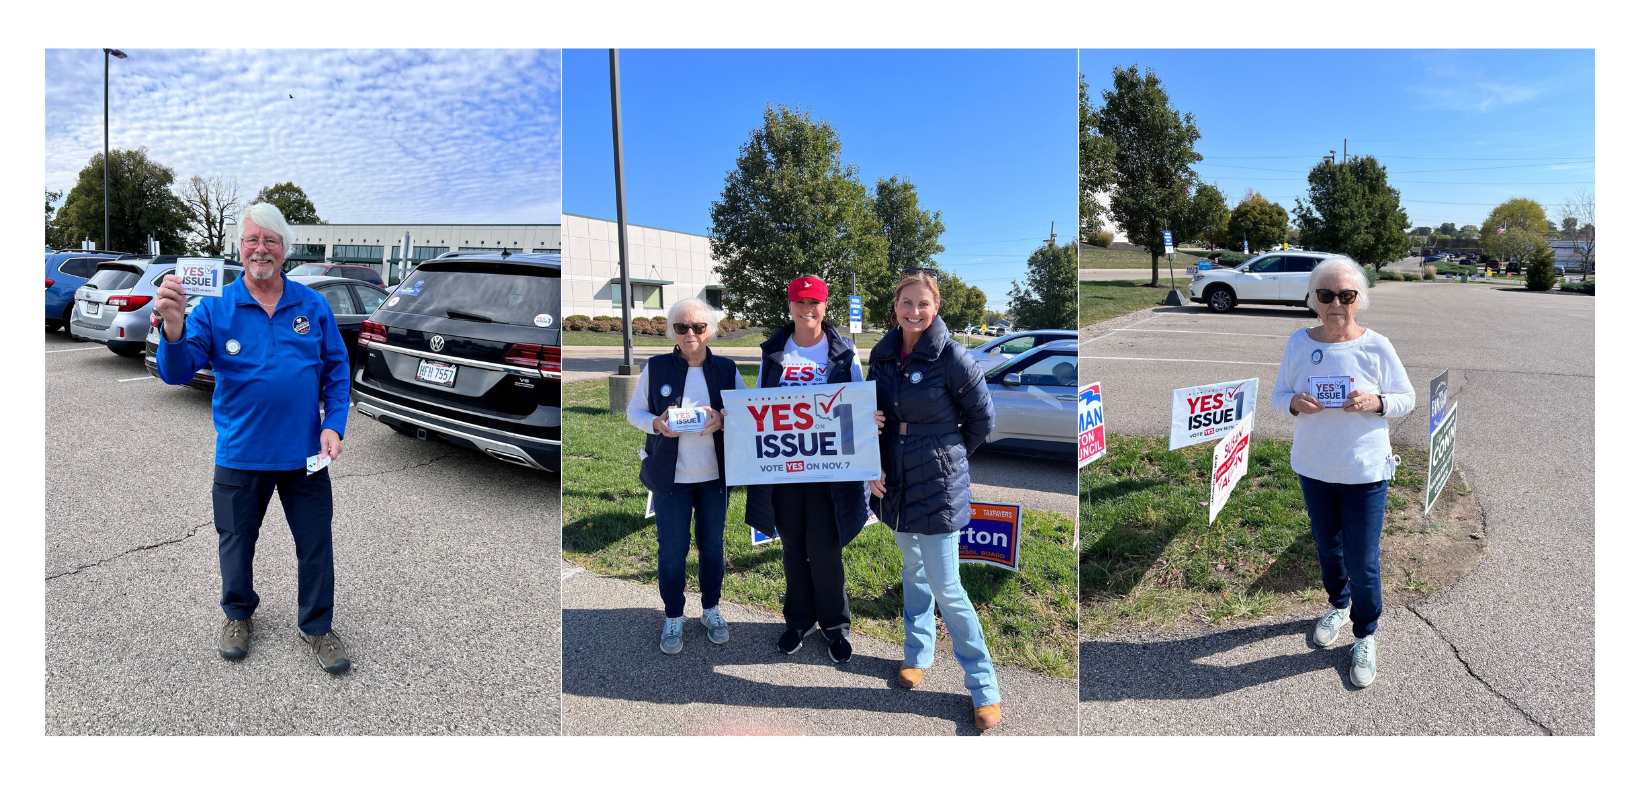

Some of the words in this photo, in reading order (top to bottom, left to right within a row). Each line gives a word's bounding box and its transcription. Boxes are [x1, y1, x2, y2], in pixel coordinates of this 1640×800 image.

[183, 266, 204, 277] YES
[182, 277, 211, 287] ISSUE
[435, 368, 454, 381] 7557
[1315, 383, 1335, 392] YES
[1317, 391, 1341, 400] ISSUE
[1187, 393, 1224, 414] YES
[1188, 408, 1234, 430] ISSUE
[1233, 391, 1245, 421] 1
[676, 417, 697, 425] ISSUE
[746, 402, 814, 433] YES
[755, 431, 838, 459] ISSUE
[832, 403, 855, 456] 1
[760, 464, 784, 472] VOTE
[786, 462, 804, 471] YES
[806, 462, 820, 471] ON
[822, 461, 844, 470] NOV.
